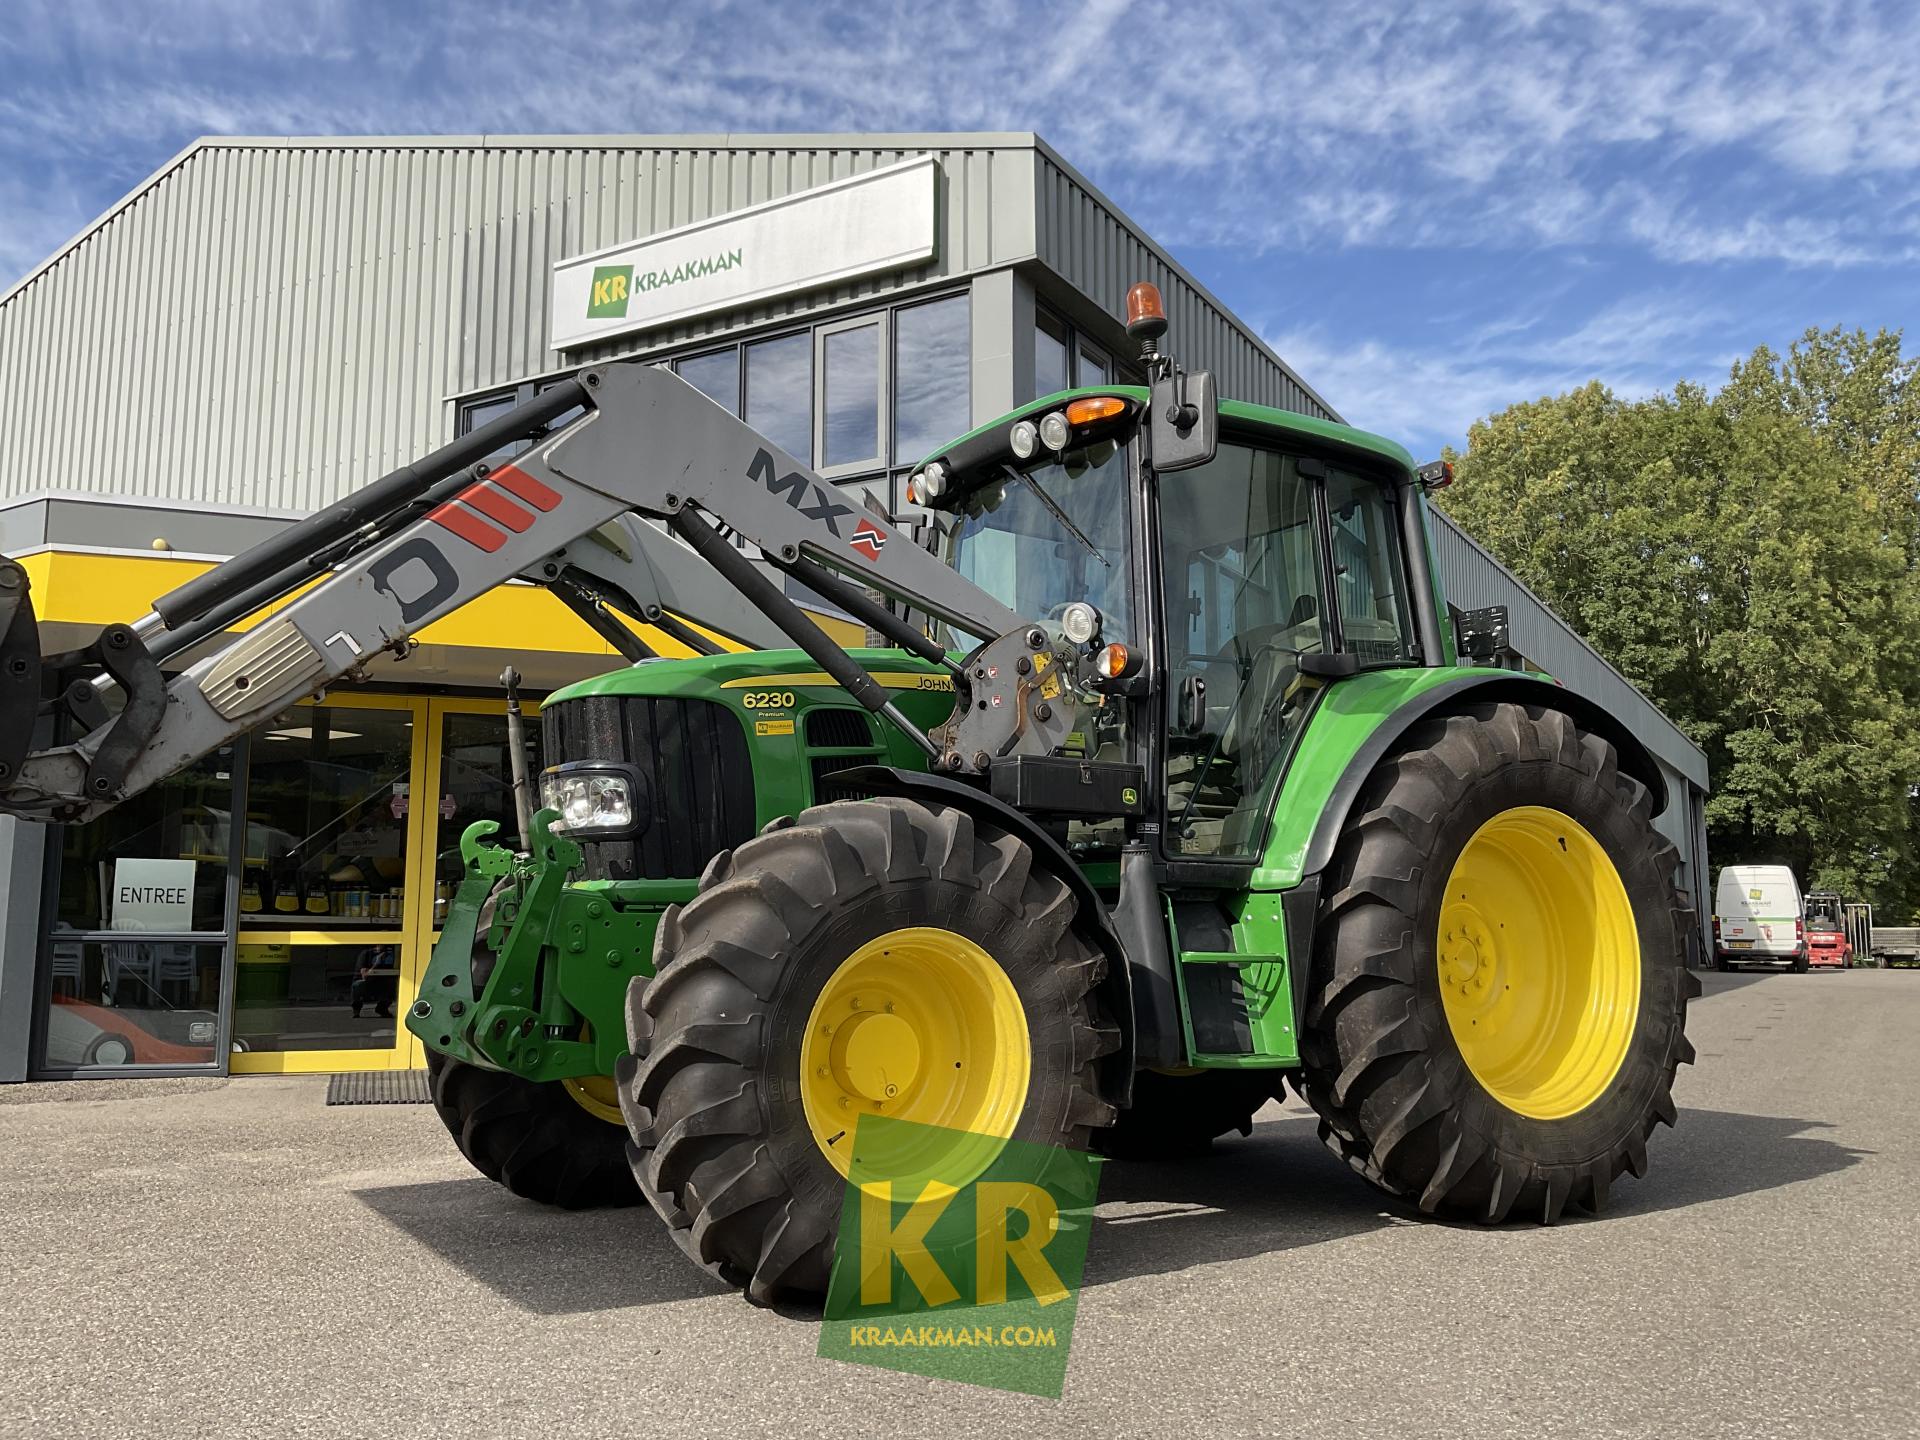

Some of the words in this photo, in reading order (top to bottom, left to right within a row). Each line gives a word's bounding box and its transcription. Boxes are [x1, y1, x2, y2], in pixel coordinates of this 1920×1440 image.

[594, 275, 628, 307] KR
[635, 248, 743, 294] KRAAKMAN
[746, 447, 855, 539] MX
[917, 676, 951, 691] JOHN
[743, 692, 796, 709] 6230
[120, 887, 187, 905] ENTREE
